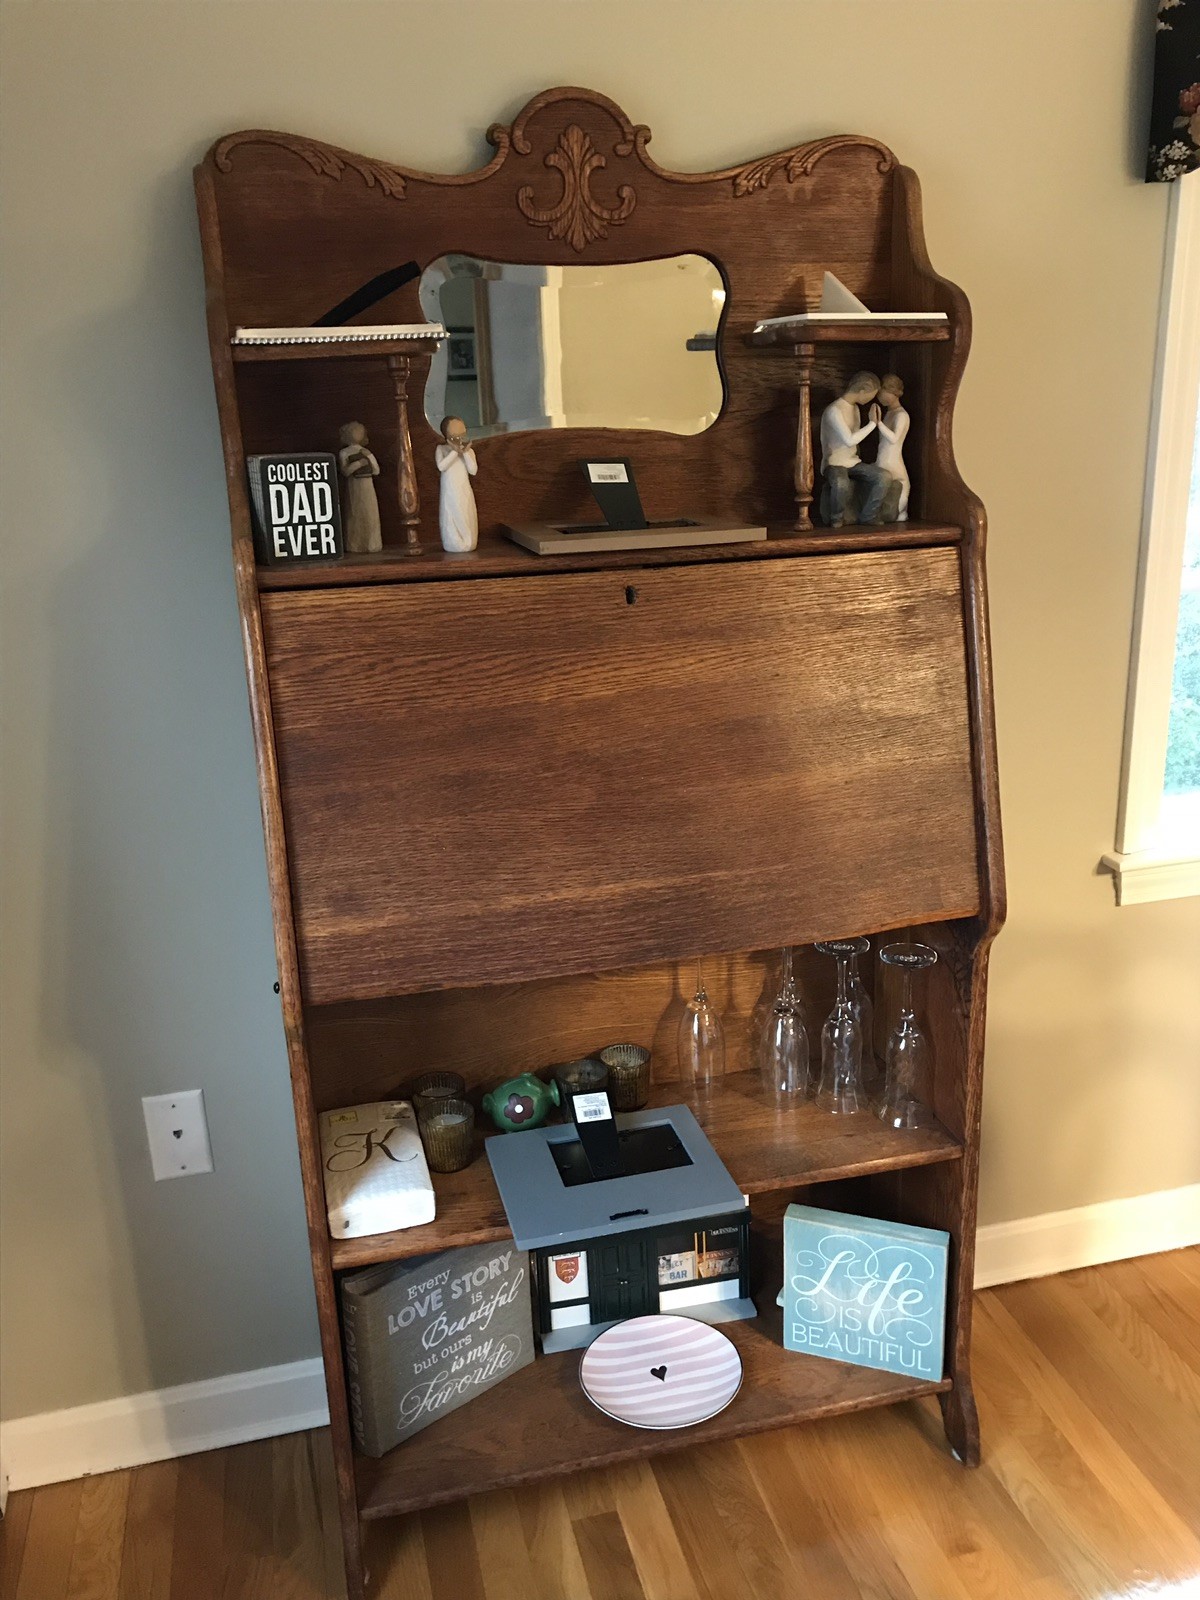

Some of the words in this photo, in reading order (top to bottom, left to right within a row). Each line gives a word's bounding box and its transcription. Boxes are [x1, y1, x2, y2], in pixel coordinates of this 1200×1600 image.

[267, 462, 329, 482] COOLEST
[269, 482, 333, 525] DAD
[272, 524, 336, 557] EVER
[326, 1125, 418, 1172] K
[388, 1289, 444, 1335] LOVE
[451, 1251, 512, 1299] STORY
[407, 1269, 451, 1301] Every
[670, 1270, 687, 1280] BAR
[791, 1234, 934, 1336] Life
[421, 1267, 525, 1350] Beautiful
[471, 1291, 483, 1305] is
[839, 1306, 861, 1331] IS
[414, 1357, 439, 1375] but
[441, 1334, 472, 1357] ours
[451, 1356, 465, 1373] is
[467, 1338, 494, 1364] my
[792, 1323, 931, 1372] BEAUTIFUL
